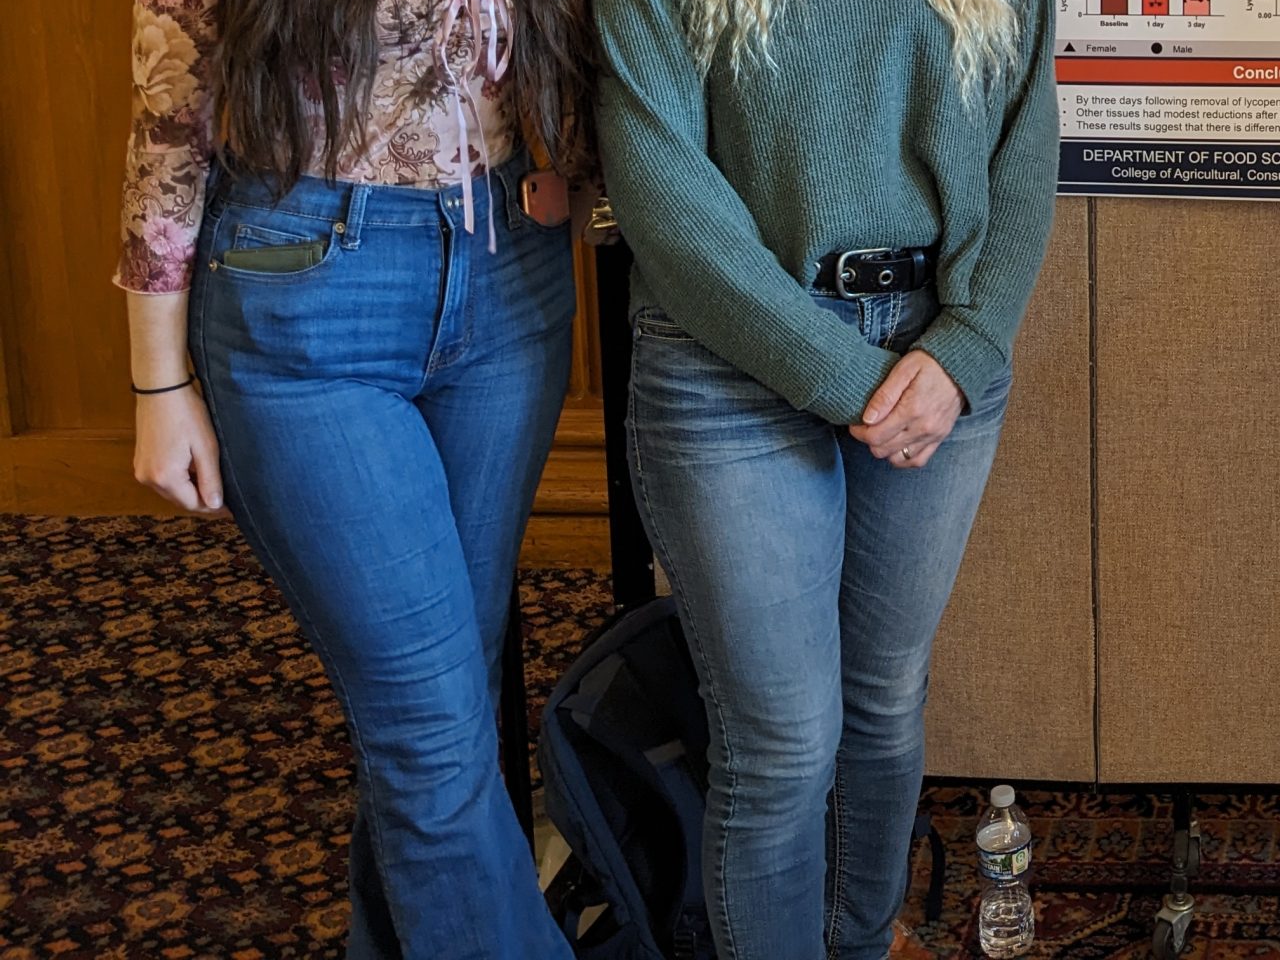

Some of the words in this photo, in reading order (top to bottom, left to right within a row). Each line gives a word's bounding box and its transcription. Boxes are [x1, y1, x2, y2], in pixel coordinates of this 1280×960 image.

[1086, 44, 1116, 52] Female
[1173, 45, 1192, 53] Male
[1076, 95, 1089, 106] By
[1092, 96, 1116, 105] three
[1119, 96, 1142, 107] days
[1145, 96, 1187, 108] following
[1191, 97, 1229, 106] removal
[1232, 97, 1242, 106] of
[1076, 108, 1103, 117] Other
[1106, 109, 1140, 118] tissues
[1143, 109, 1161, 118] had
[1164, 109, 1200, 119] modest
[1203, 110, 1252, 119] reductions
[1256, 110, 1278, 119] after
[1076, 121, 1106, 130] These
[1109, 121, 1141, 131] results
[1144, 122, 1182, 134] suggest
[1185, 123, 1203, 132] that
[1206, 123, 1231, 132] there
[1234, 123, 1242, 132] is
[1083, 149, 1185, 163] DEPARTMENT
[1189, 151, 1209, 164] OF
[1214, 151, 1257, 164] FOOD
[1112, 167, 1156, 181] College
[1160, 168, 1172, 179] of
[1173, 168, 1243, 183] Agricultural,
